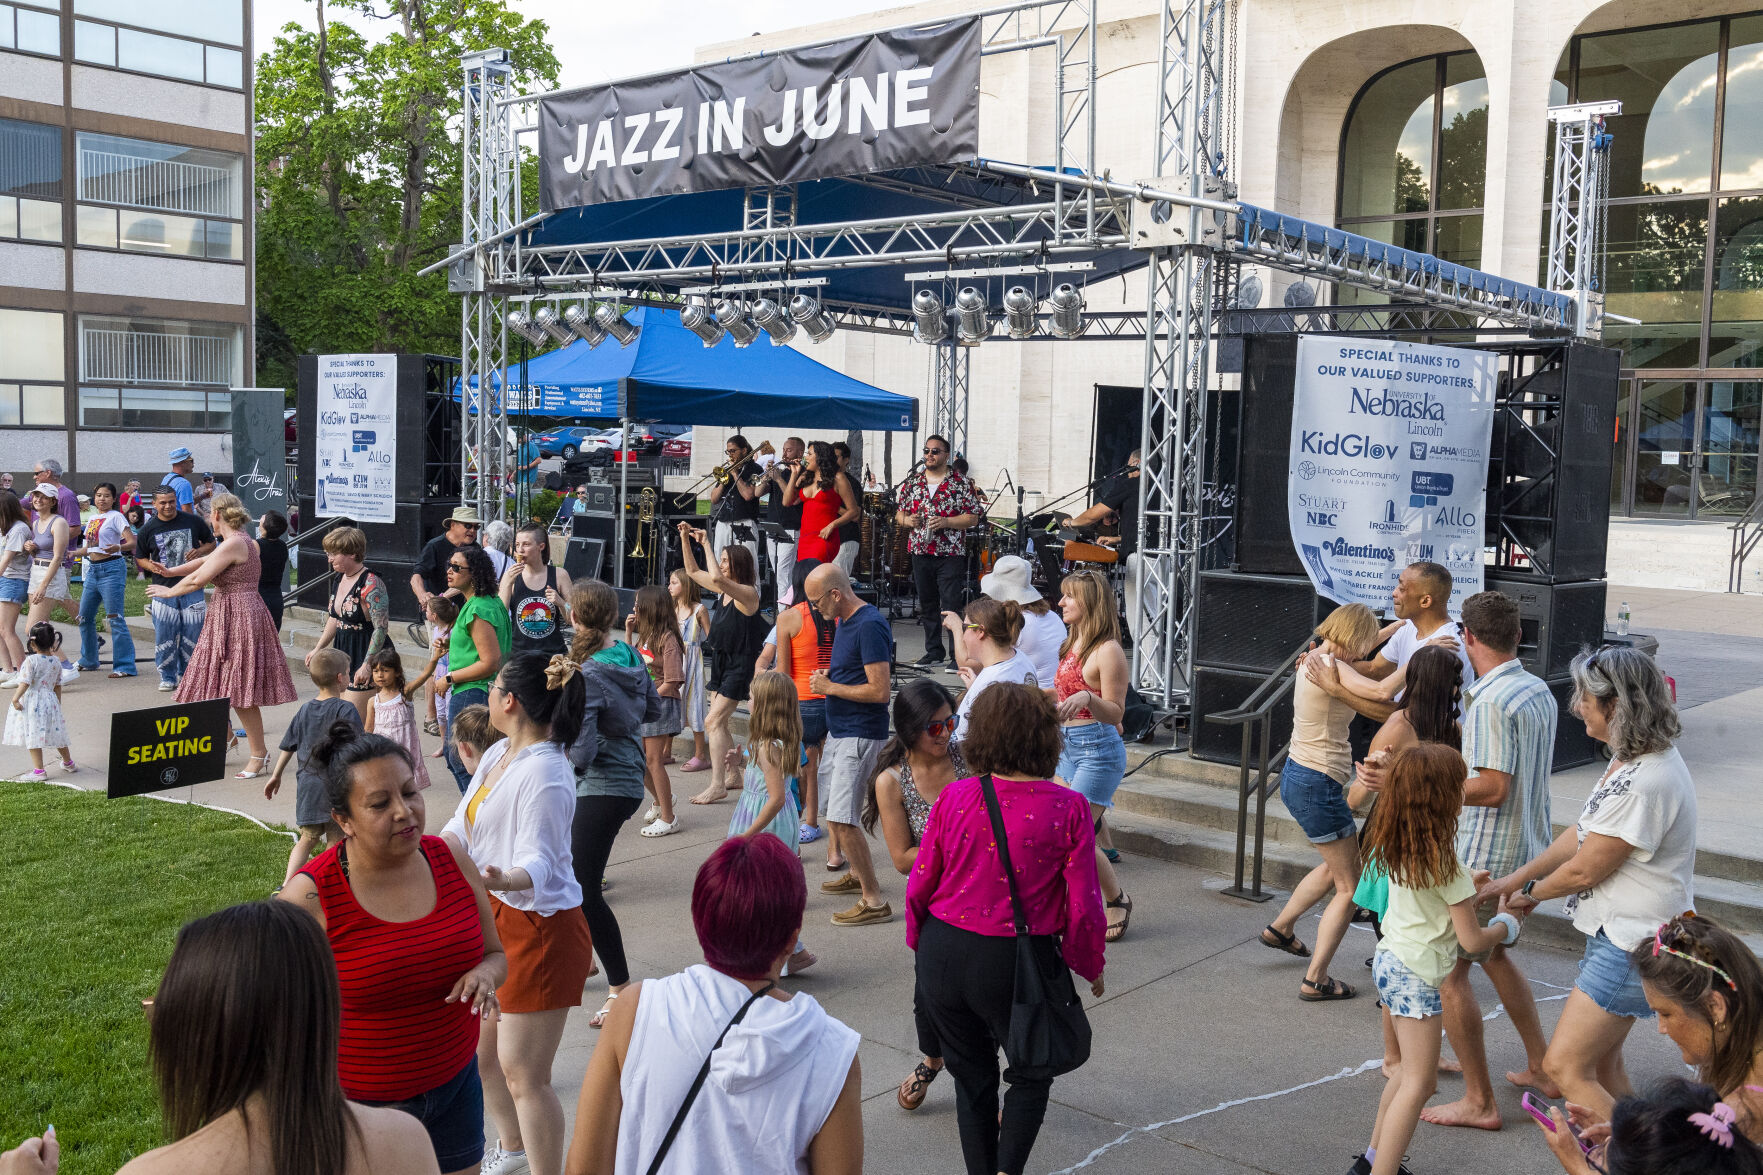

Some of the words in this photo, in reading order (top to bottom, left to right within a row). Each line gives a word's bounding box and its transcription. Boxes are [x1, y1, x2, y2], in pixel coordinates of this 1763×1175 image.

[563, 107, 683, 174] JAZZ
[698, 97, 745, 154] IN
[764, 66, 934, 147] JUNE
[1340, 348, 1394, 362] SPECIAL
[1400, 353, 1442, 367] THANKS
[1446, 358, 1460, 369] TO
[1318, 365, 1346, 376] OUR
[1352, 367, 1402, 381] VALUED
[1389, 390, 1422, 400] UNIVERSITY
[1348, 387, 1445, 421] Nebraska
[1407, 421, 1443, 437] Lincoln
[1301, 430, 1399, 460] KidGlov
[237, 458, 270, 487] Alexis
[1317, 465, 1349, 478] Lincoln
[1350, 468, 1400, 482] Community
[1415, 475, 1431, 486] UBT
[1331, 479, 1387, 488] FOUNDATION
[1298, 493, 1348, 510] STUART
[1307, 511, 1338, 527] NBC
[1322, 537, 1395, 562] Valentino's
[1406, 543, 1433, 559] KZUM
[1445, 561, 1474, 570] LEGACY
[1355, 570, 1384, 580] ACKLIE
[155, 716, 190, 737] VIP
[127, 736, 212, 765] SEATING
